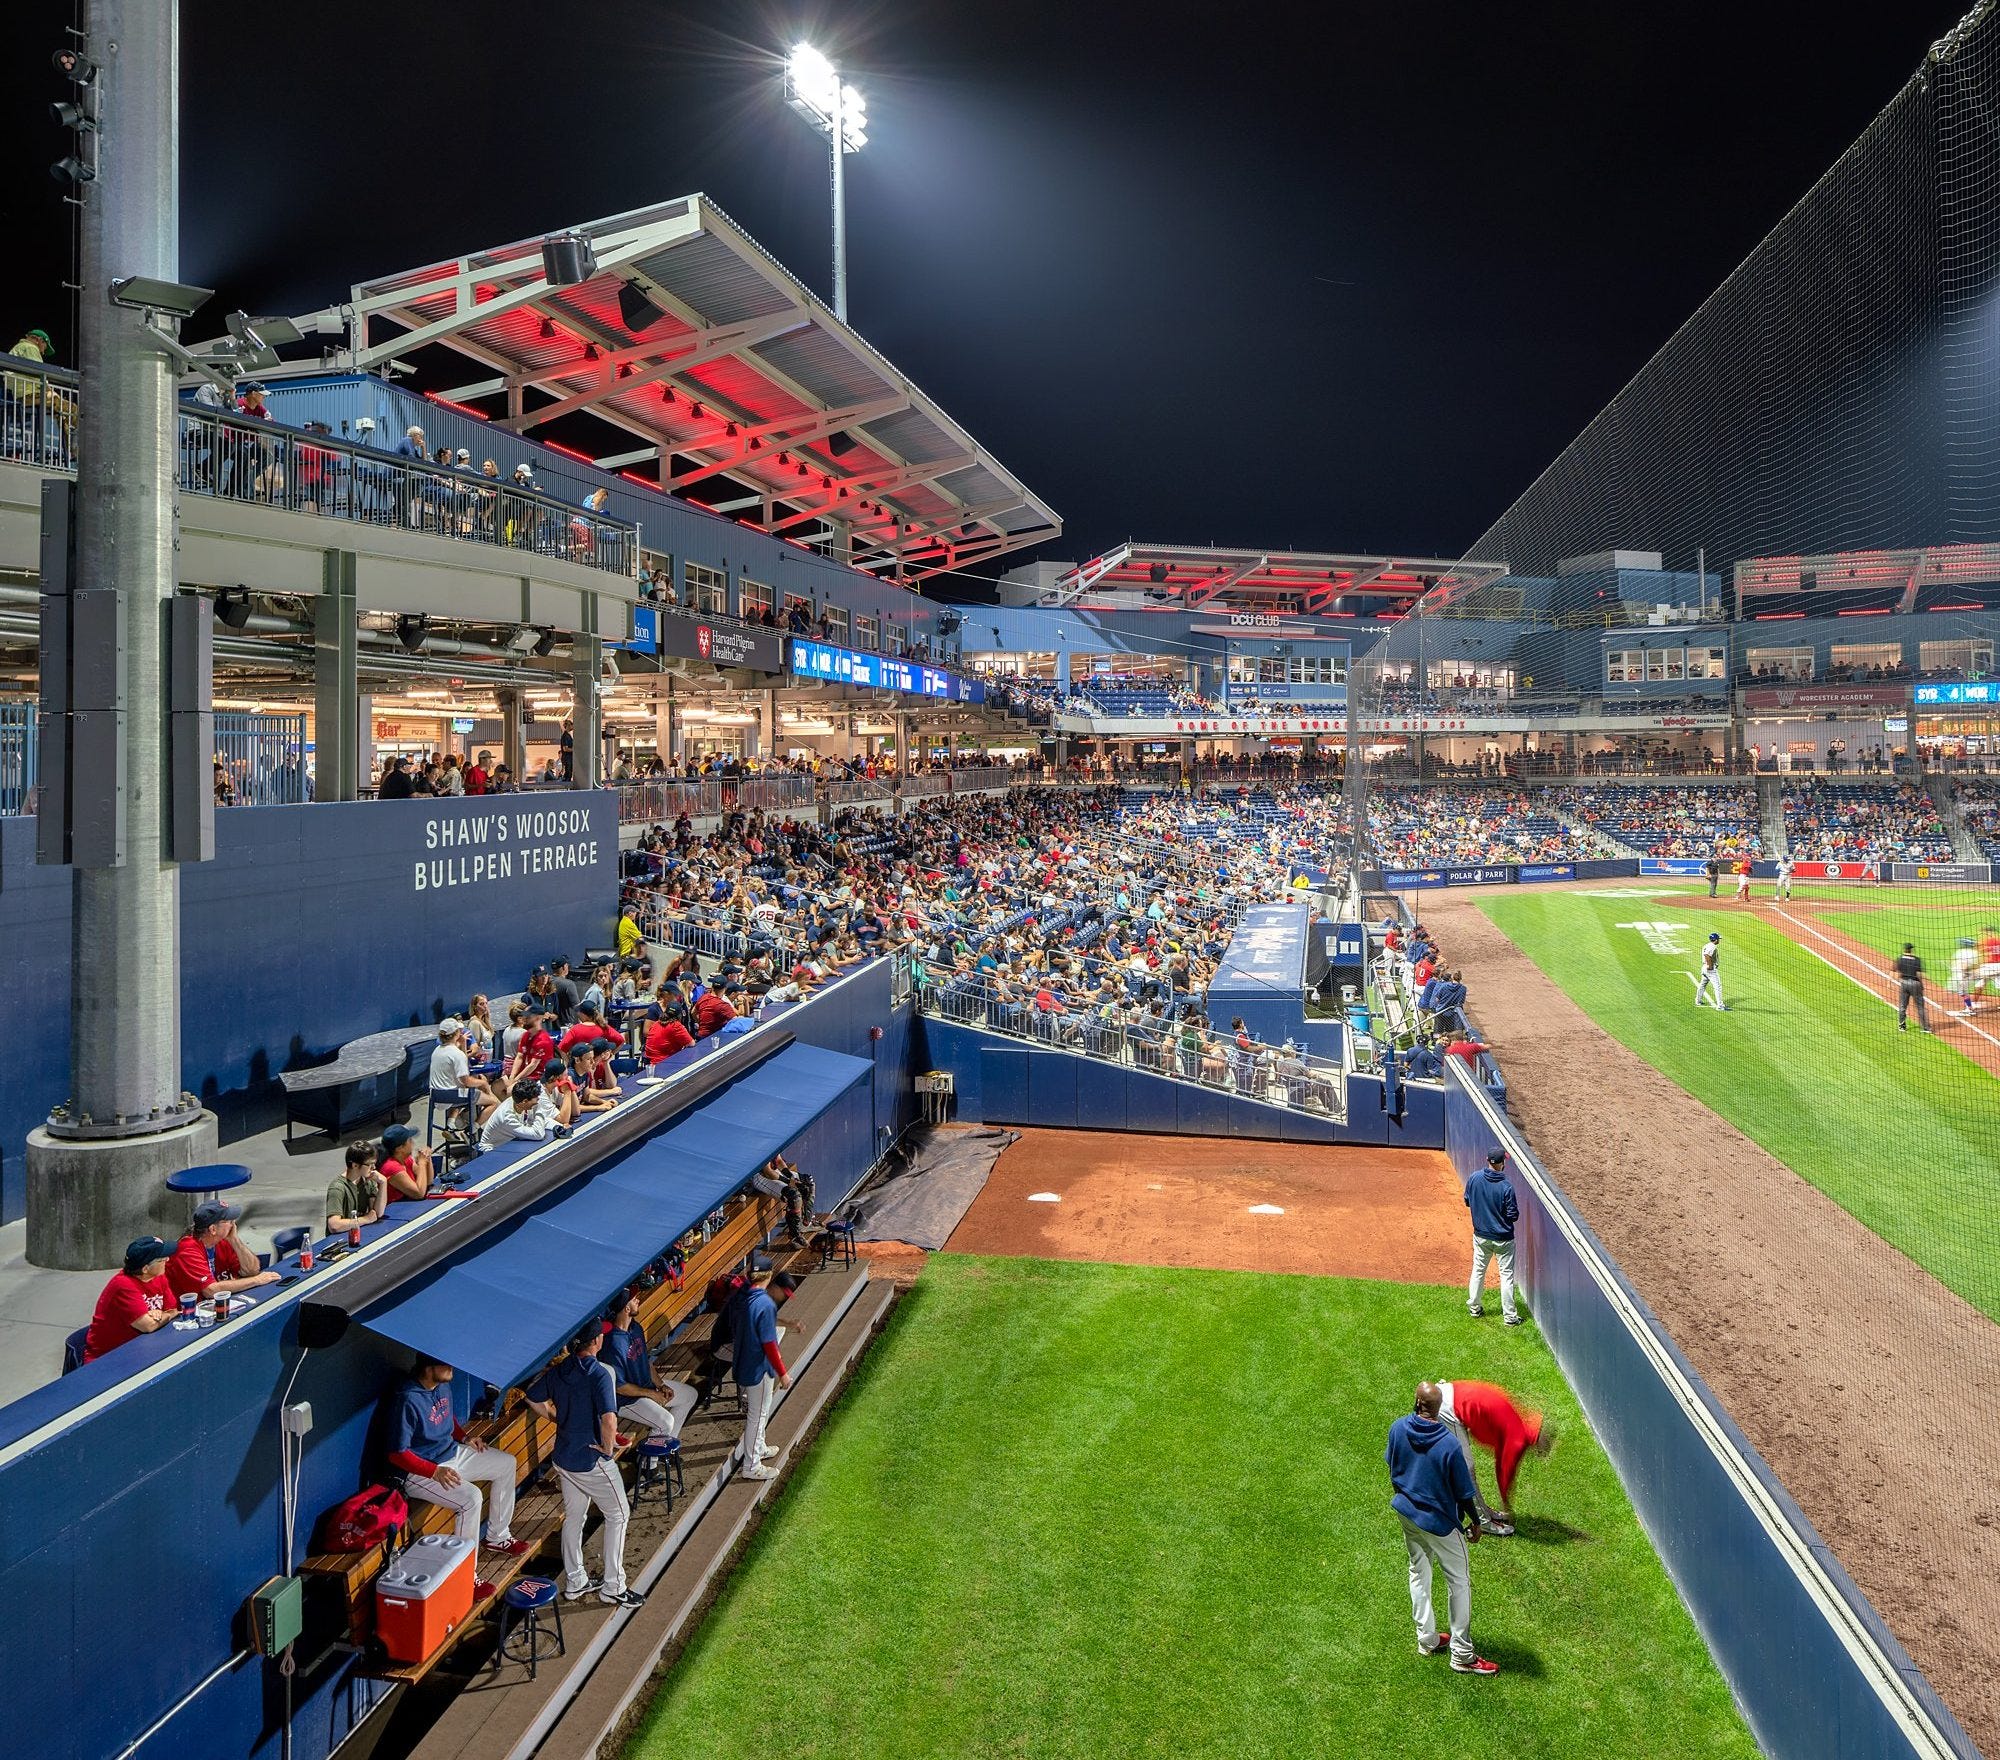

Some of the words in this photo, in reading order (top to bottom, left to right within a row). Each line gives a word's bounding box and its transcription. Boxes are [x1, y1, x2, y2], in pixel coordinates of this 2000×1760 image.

[1230, 614, 1254, 625] DCU
[1255, 615, 1280, 626] CLUB
[712, 629, 735, 647] Harvard
[735, 633, 755, 652] Pilgrim
[712, 644, 732, 661] Health
[731, 648, 745, 663] Care
[1917, 688, 1938, 700] SYR
[1950, 687, 1959, 699] 4
[1177, 721, 1219, 730] HOME
[1231, 721, 1248, 730] OF
[1261, 721, 1288, 730] THE
[1402, 721, 1430, 730] RED
[1440, 721, 1466, 730] SOX
[1942, 723, 1986, 733] NACHO
[426, 814, 508, 849] SHAW'S
[516, 809, 590, 840] WOOSOX
[415, 852, 512, 891] BULLPEN
[520, 841, 598, 875] TERRACE
[758, 911, 775, 921] 25
